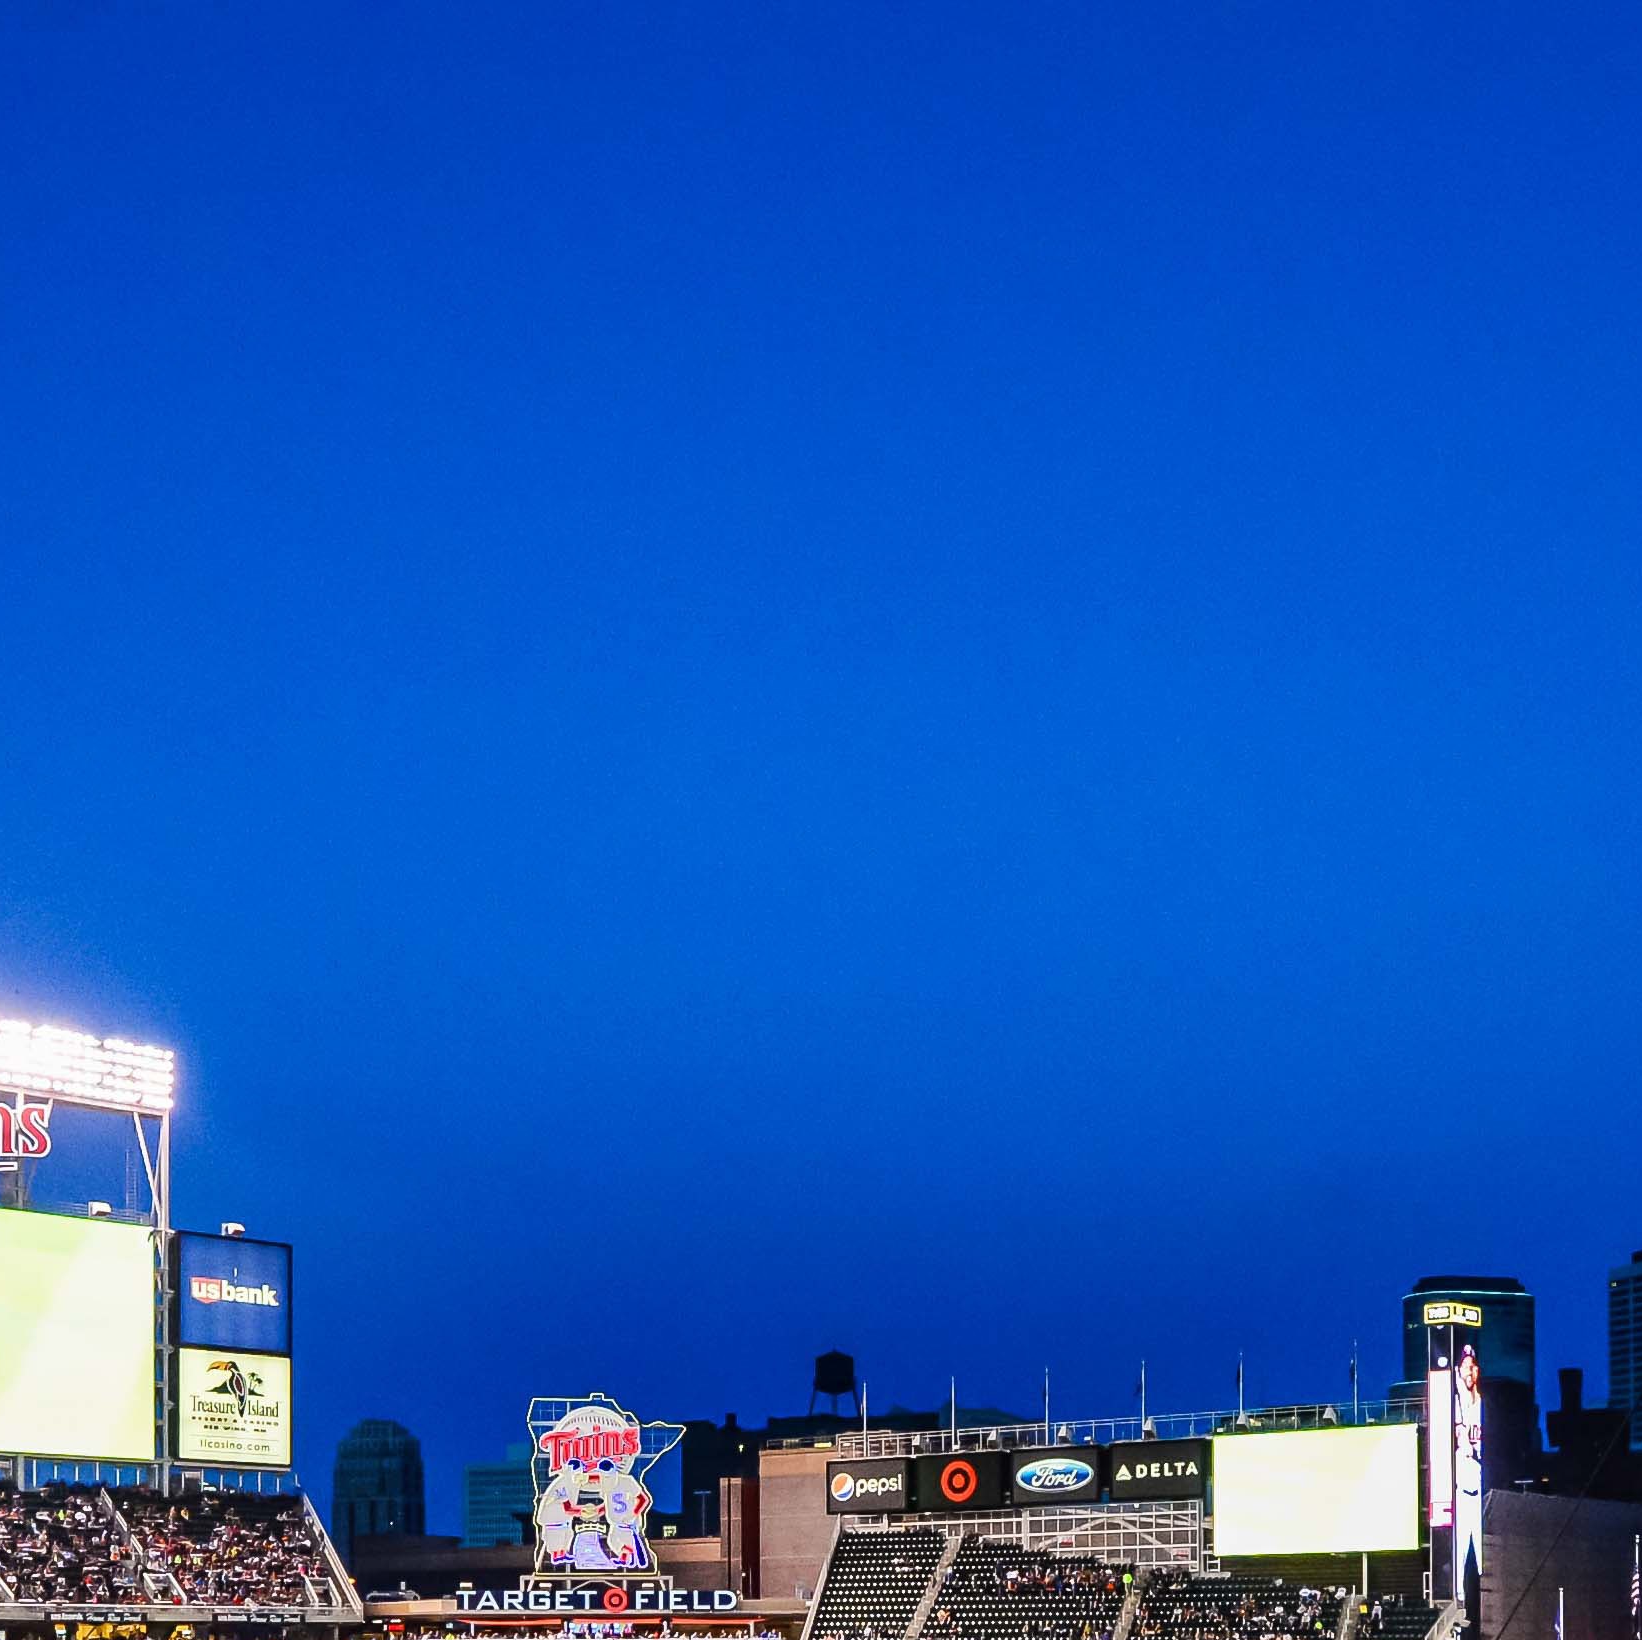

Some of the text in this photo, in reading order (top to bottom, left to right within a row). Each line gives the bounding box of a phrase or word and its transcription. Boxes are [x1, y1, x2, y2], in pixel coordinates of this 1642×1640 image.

[190, 1395, 279, 1418] Treasure Island
[540, 1424, 640, 1474] Twins
[1032, 1464, 1078, 1488] Ford
[1135, 1461, 1199, 1479] DELTA
[855, 1473, 903, 1497] pepsi
[456, 1590, 738, 1610] TARGET FIELD
